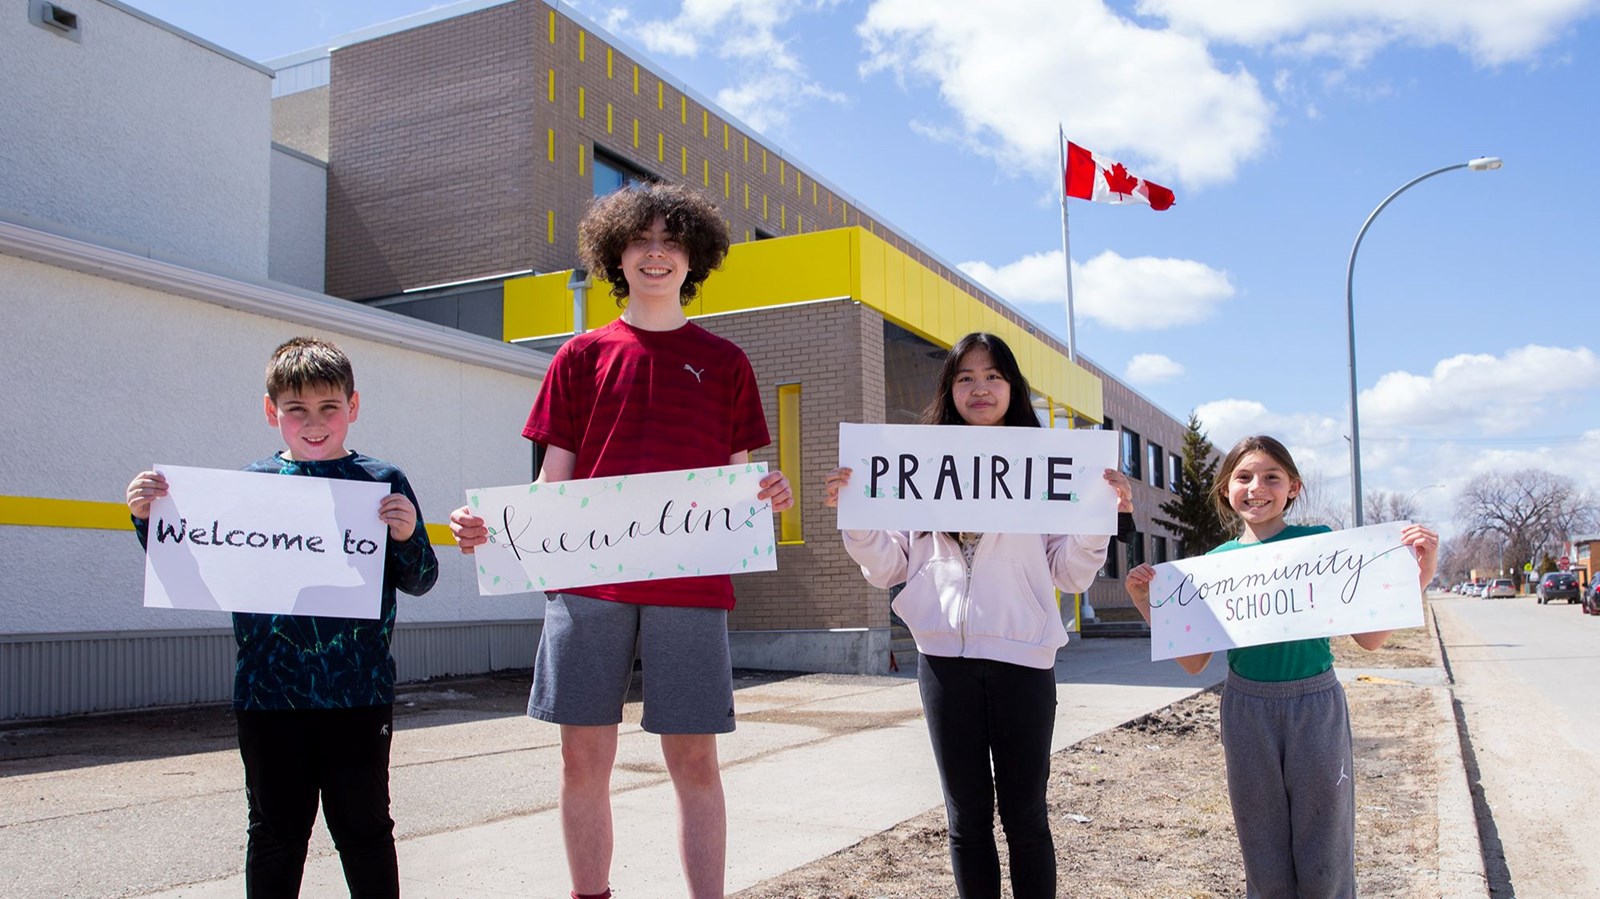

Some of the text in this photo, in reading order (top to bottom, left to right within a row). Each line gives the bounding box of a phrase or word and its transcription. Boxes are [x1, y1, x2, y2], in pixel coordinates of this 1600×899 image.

[870, 453, 1073, 501] PRAIRIE
[156, 517, 379, 555] Welcome to
[497, 499, 752, 561] Keewatin
[1150, 548, 1380, 608] Community
